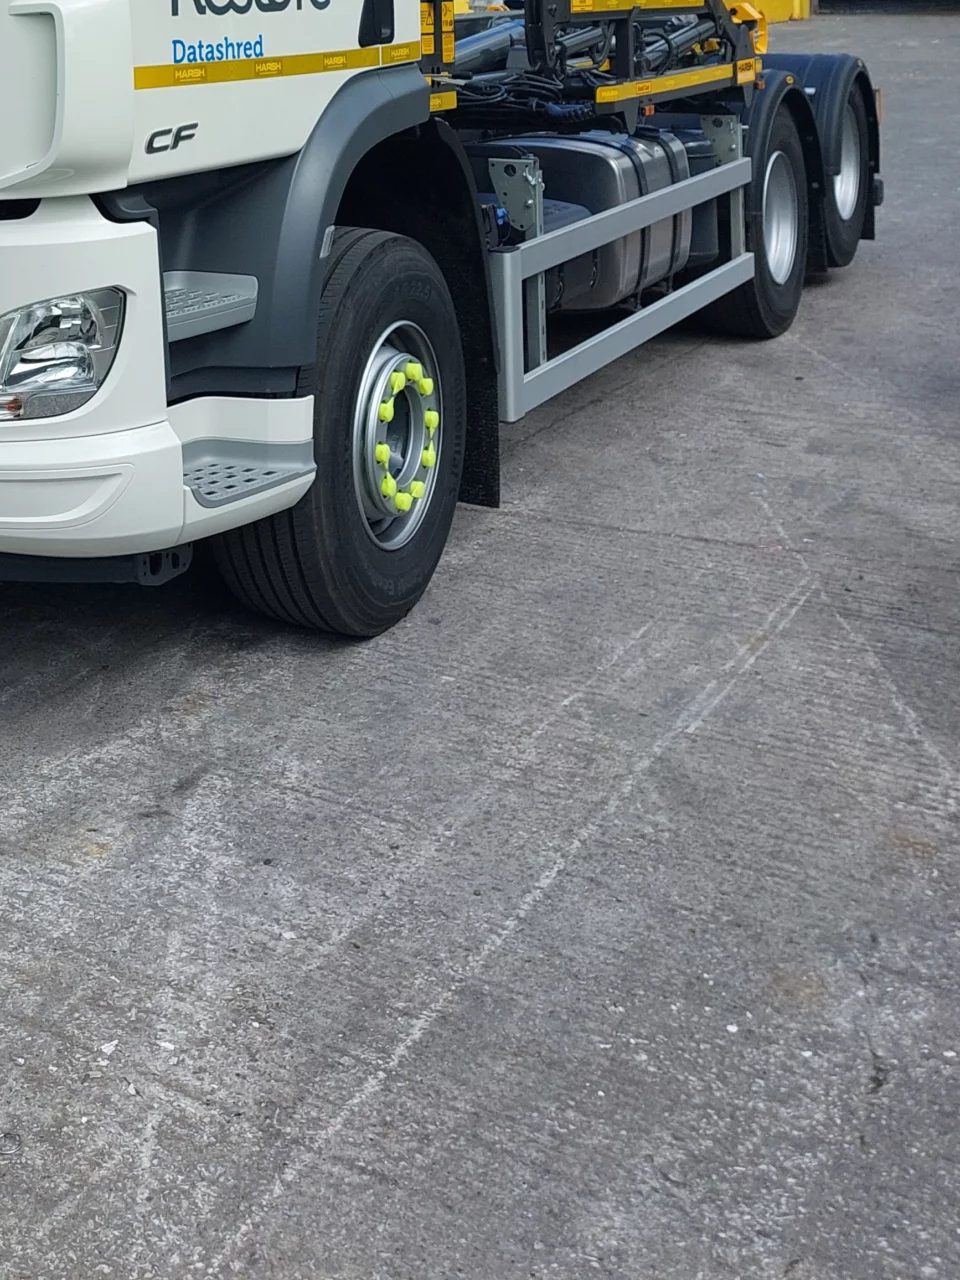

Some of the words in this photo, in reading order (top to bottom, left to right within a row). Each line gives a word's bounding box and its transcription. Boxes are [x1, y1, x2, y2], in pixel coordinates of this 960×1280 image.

[172, 34, 264, 64] Datashred
[391, 47, 410, 58] HARSH
[255, 61, 282, 73] HARSH
[324, 55, 347, 67] HARSH
[175, 68, 206, 80] HARSH
[144, 121, 199, 155] CF
